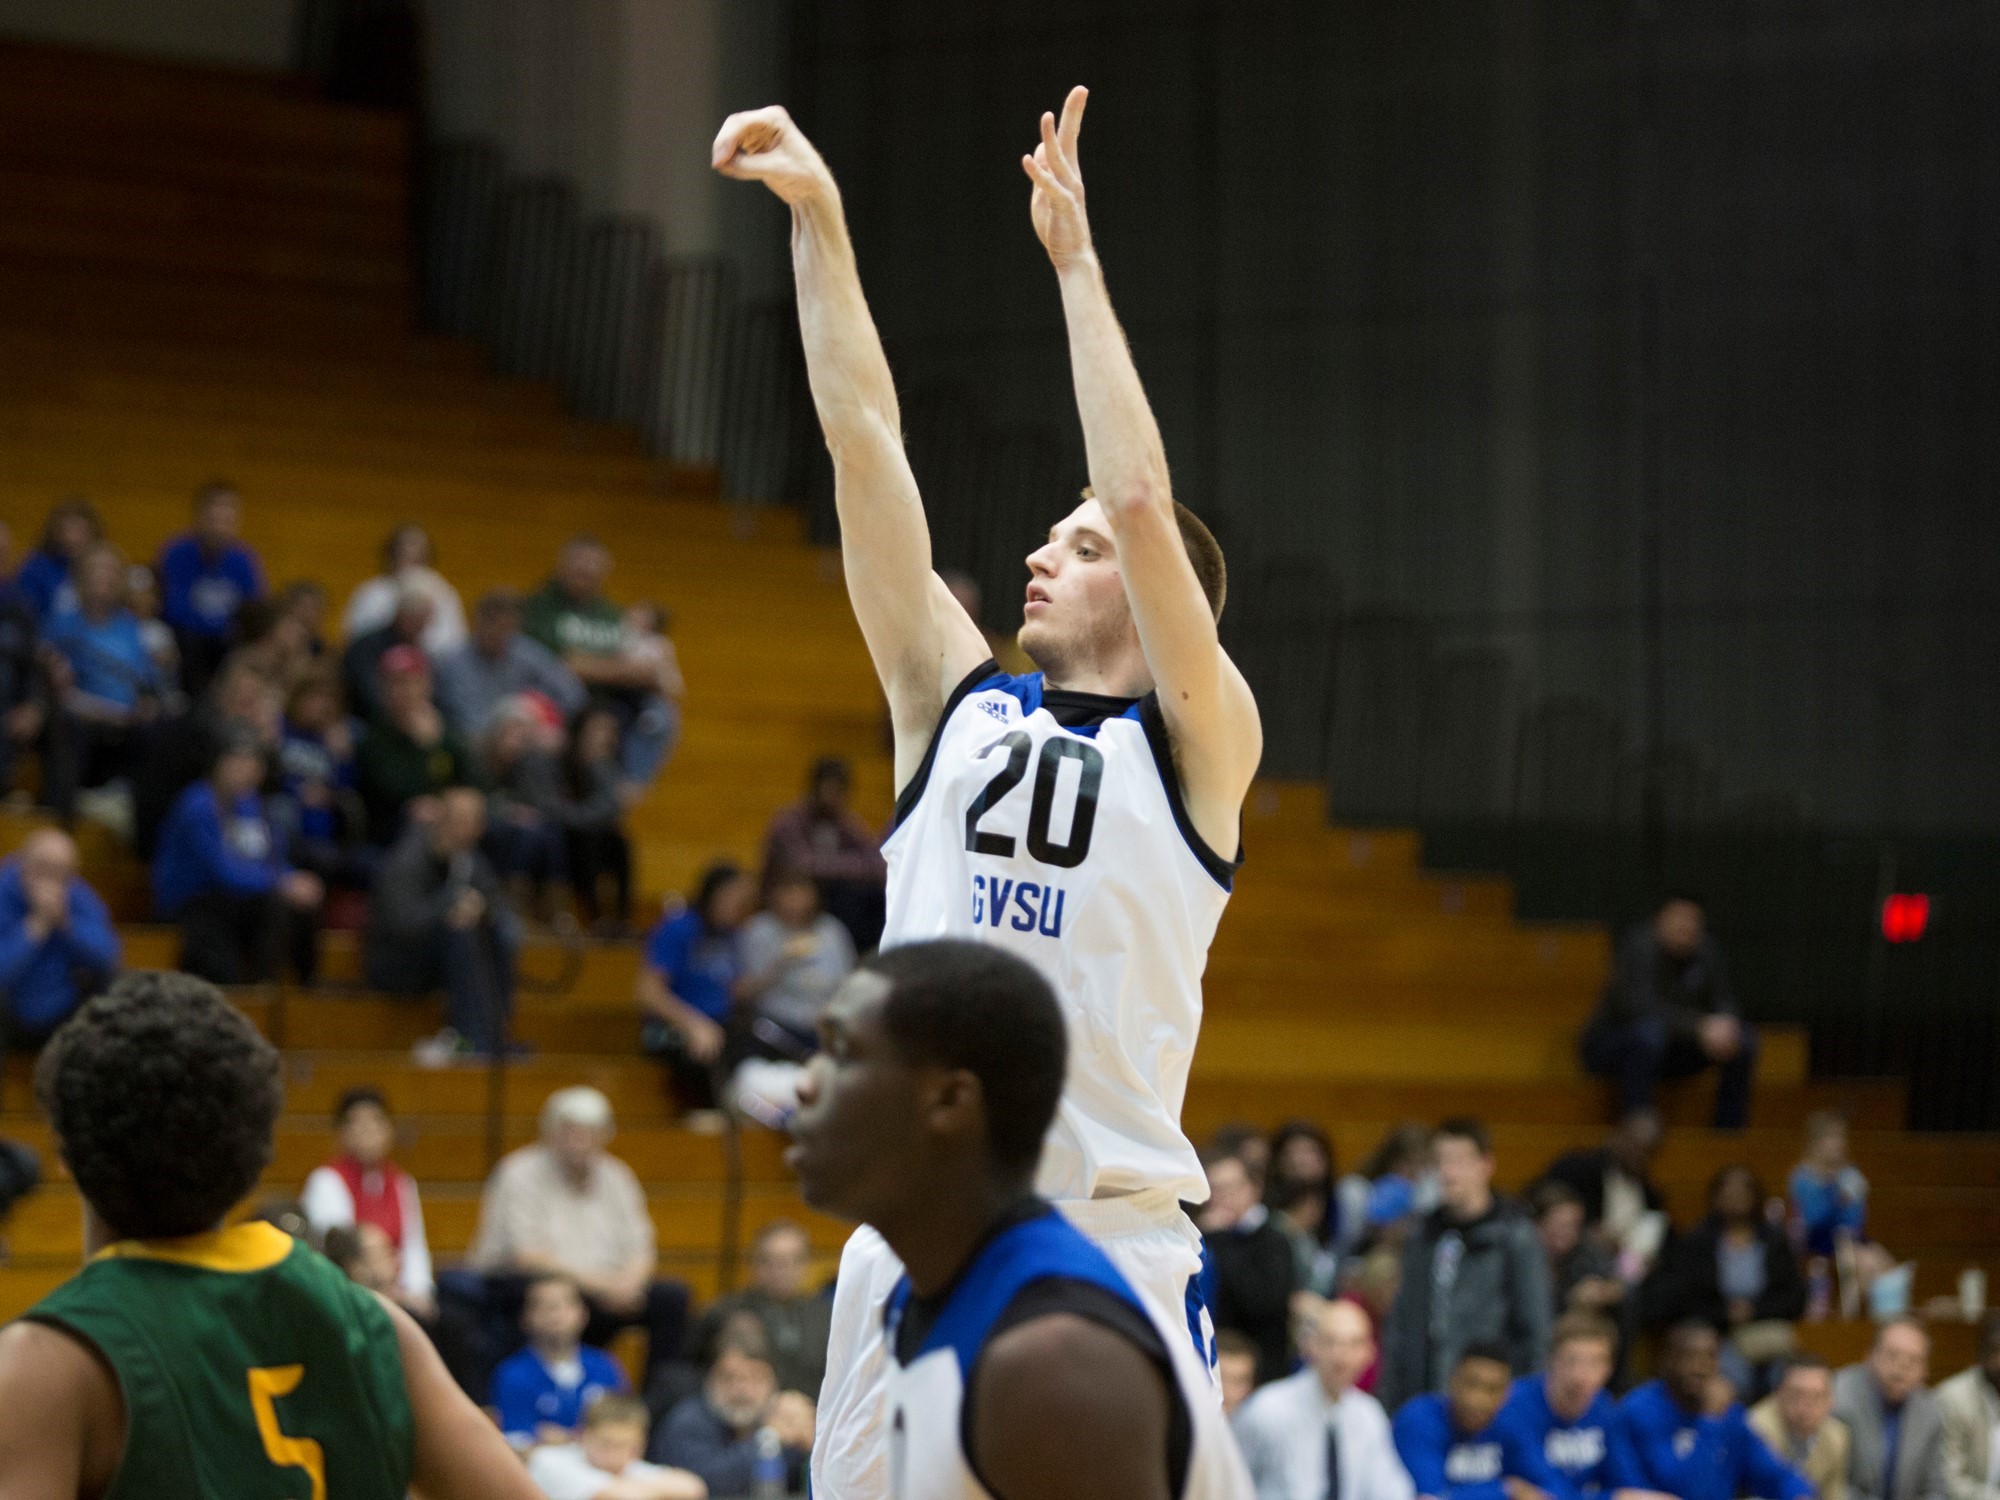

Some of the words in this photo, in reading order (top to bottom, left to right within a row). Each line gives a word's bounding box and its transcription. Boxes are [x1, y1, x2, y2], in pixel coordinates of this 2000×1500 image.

[976, 702, 1009, 725] adidas
[965, 730, 1104, 868] 20
[972, 874, 1065, 938] GVSU
[246, 1363, 327, 1500] 5
